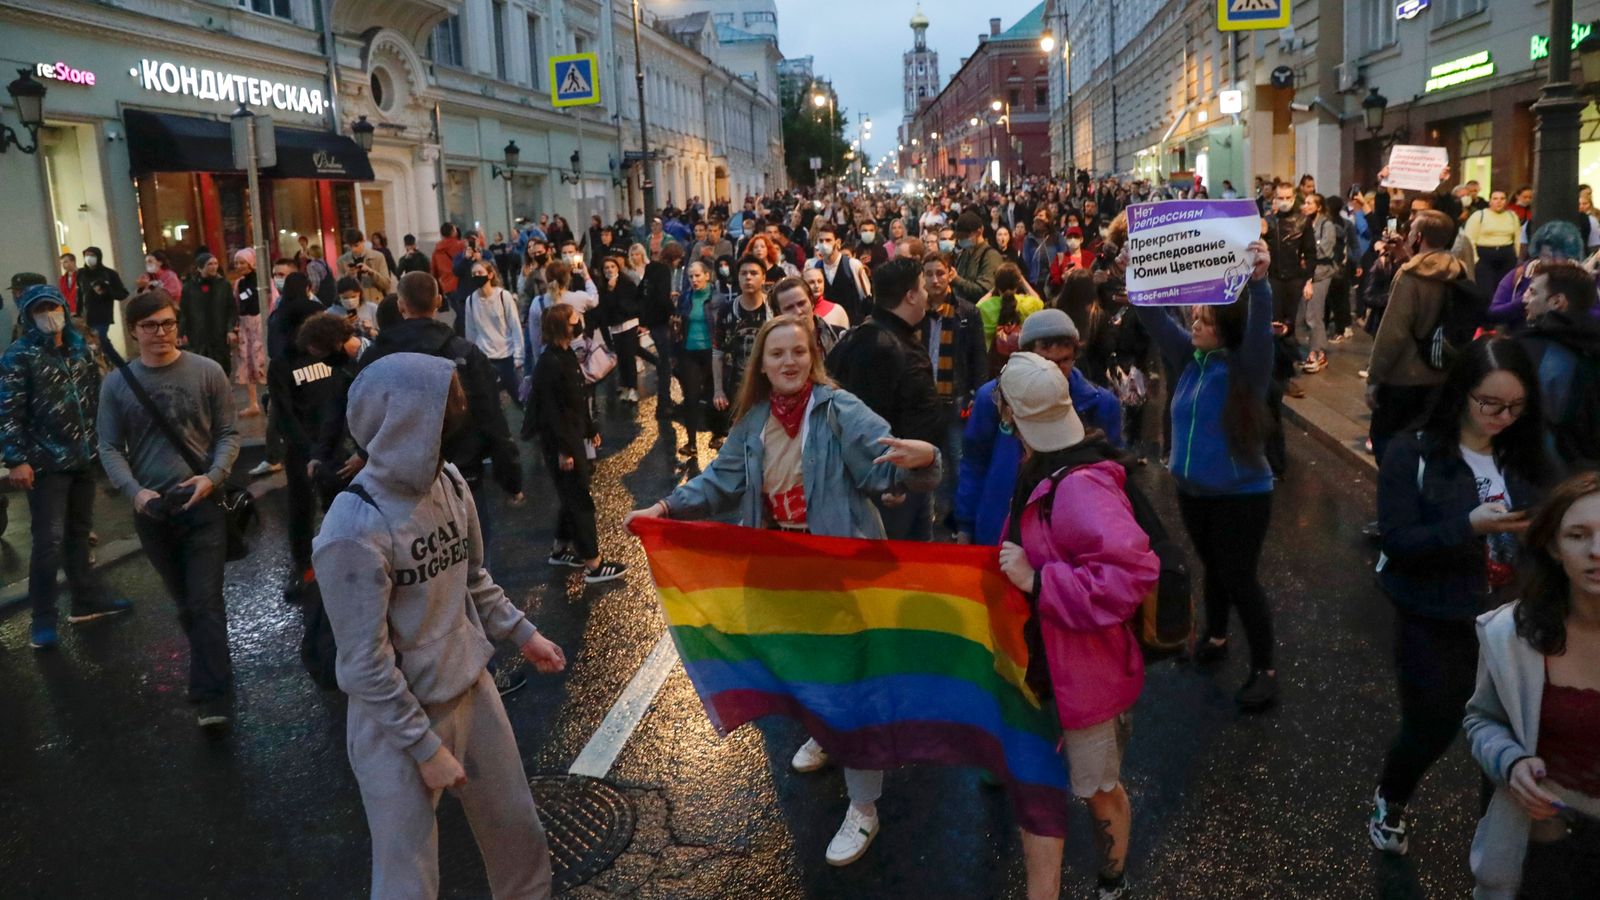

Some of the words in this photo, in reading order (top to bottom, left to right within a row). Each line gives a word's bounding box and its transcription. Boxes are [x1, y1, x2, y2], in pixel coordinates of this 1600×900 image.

[36, 62, 96, 86] re:Store
[141, 59, 324, 115] КОНДИТЕРСКАЯ
[1132, 209, 1204, 231] репрессиям
[1133, 206, 1154, 219] Нет
[1130, 229, 1201, 252] Прекратить
[1131, 238, 1227, 266] преследование
[1133, 264, 1168, 280] Юлии
[1169, 251, 1236, 275] Цветковой
[1137, 288, 1180, 302] SocFemAlt
[396, 538, 469, 586] DIGGER
